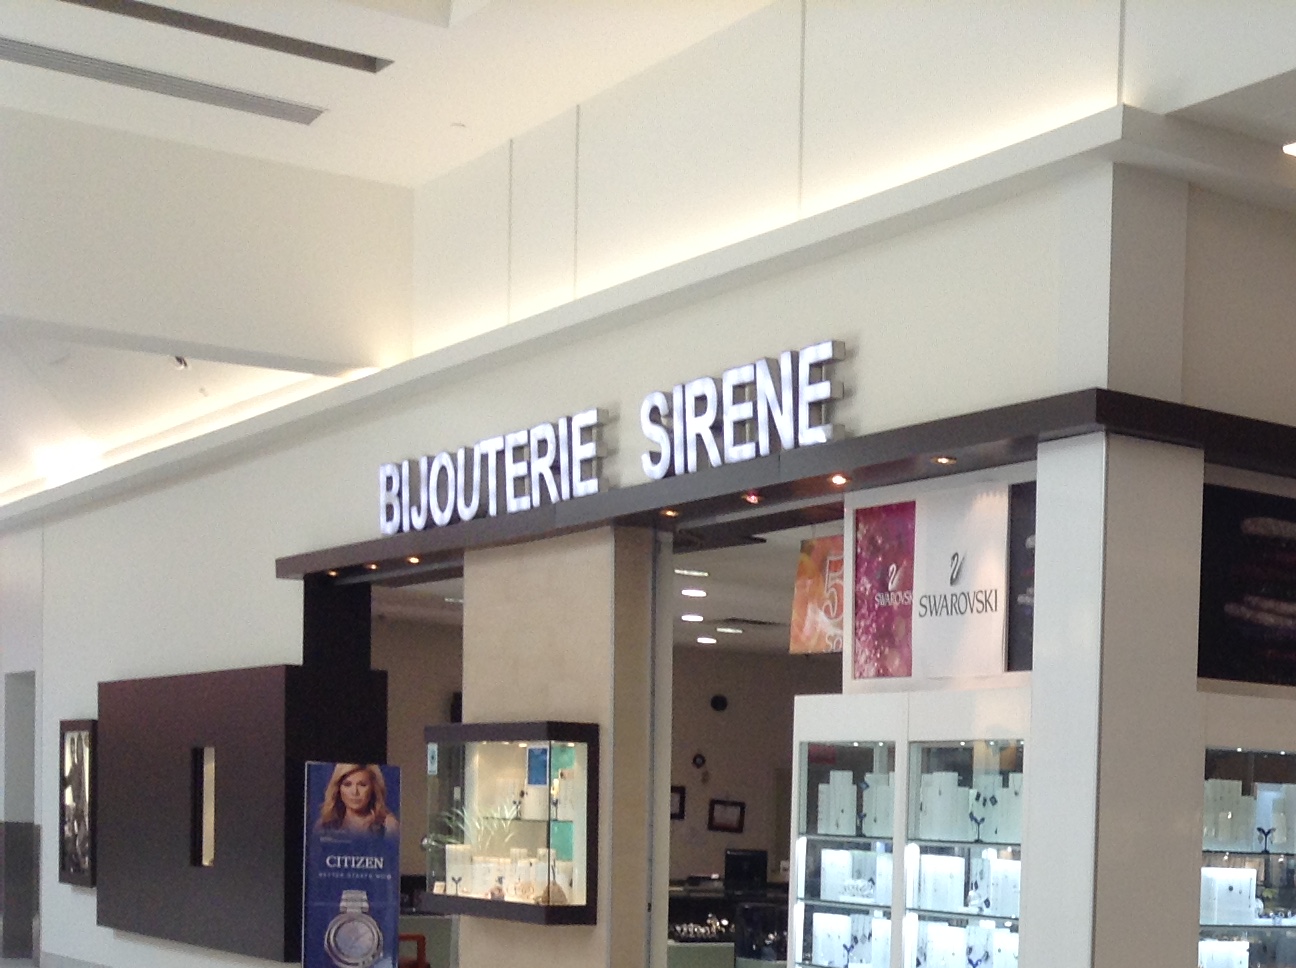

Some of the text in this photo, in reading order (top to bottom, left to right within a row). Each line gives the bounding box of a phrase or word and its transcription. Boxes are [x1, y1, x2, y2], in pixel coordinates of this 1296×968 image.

[379, 340, 840, 535] BIJOUTERIE SIRENE
[918, 588, 998, 618] SWAROVSKI
[325, 855, 384, 869] CITIZEN
